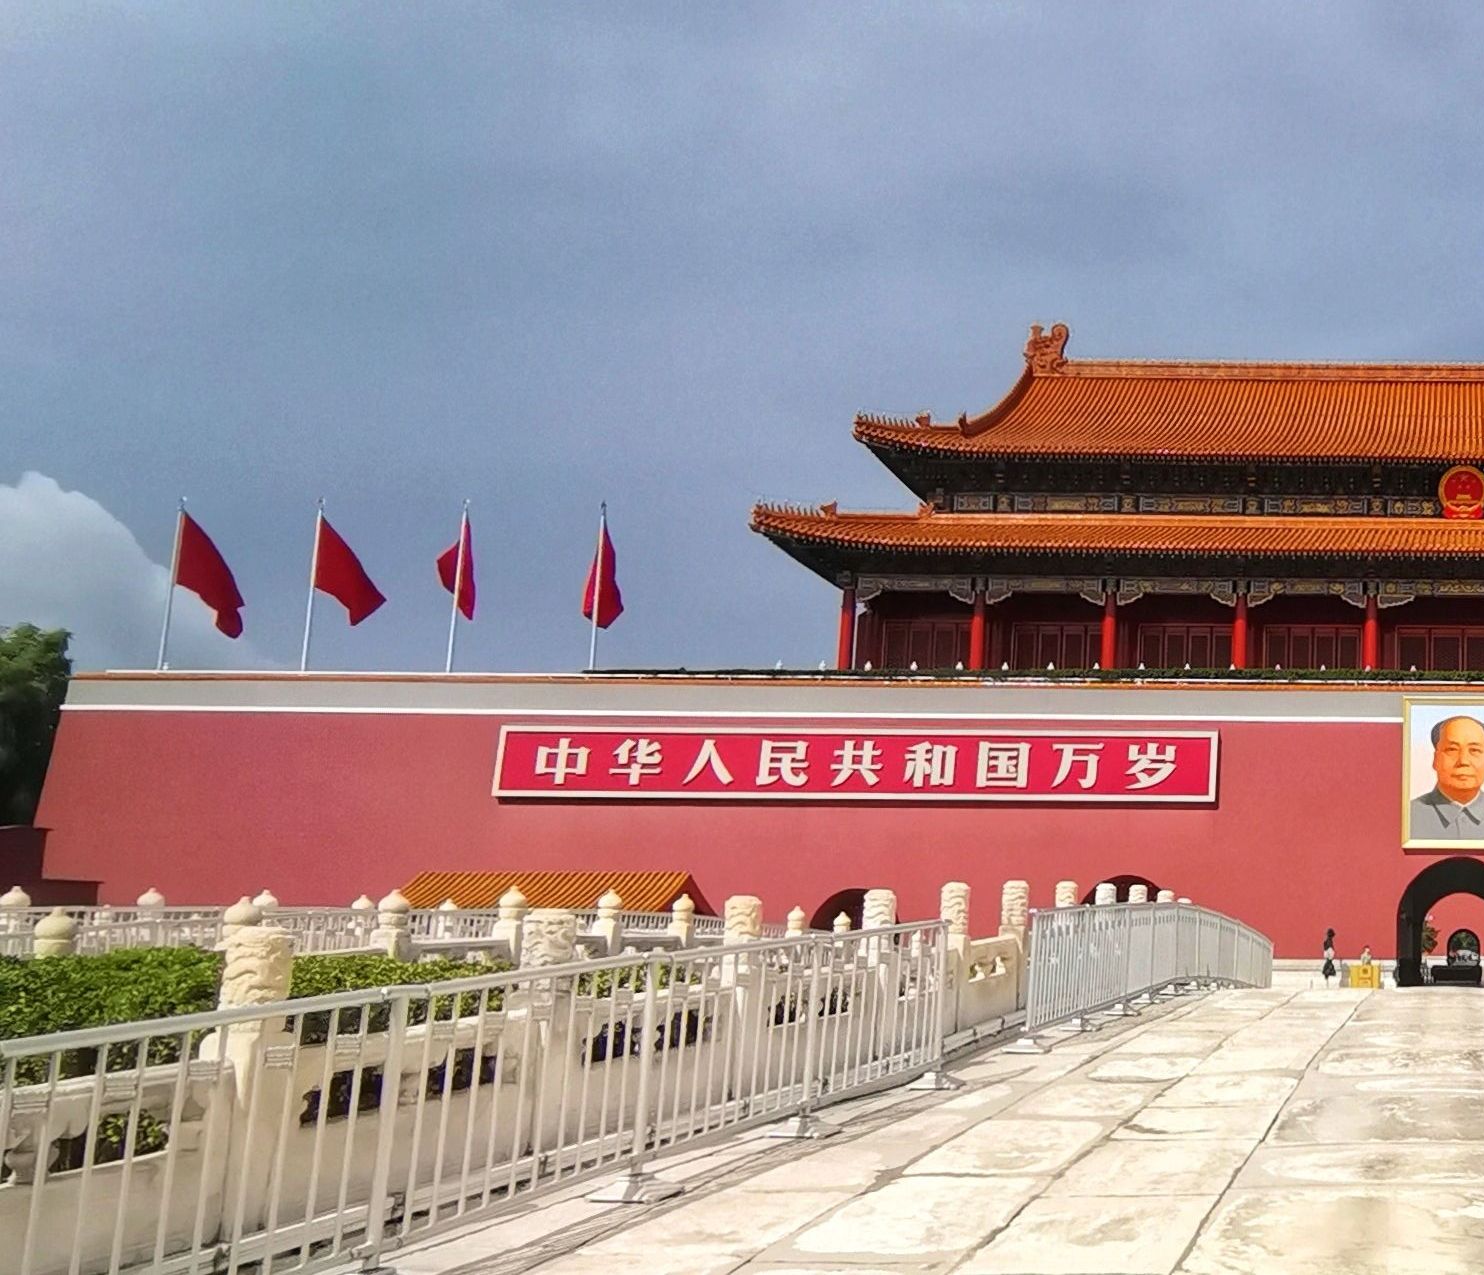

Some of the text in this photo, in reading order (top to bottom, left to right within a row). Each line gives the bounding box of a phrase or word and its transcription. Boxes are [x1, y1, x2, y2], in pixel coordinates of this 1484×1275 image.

[535, 738, 1177, 789] 中华人民共和国万岁
